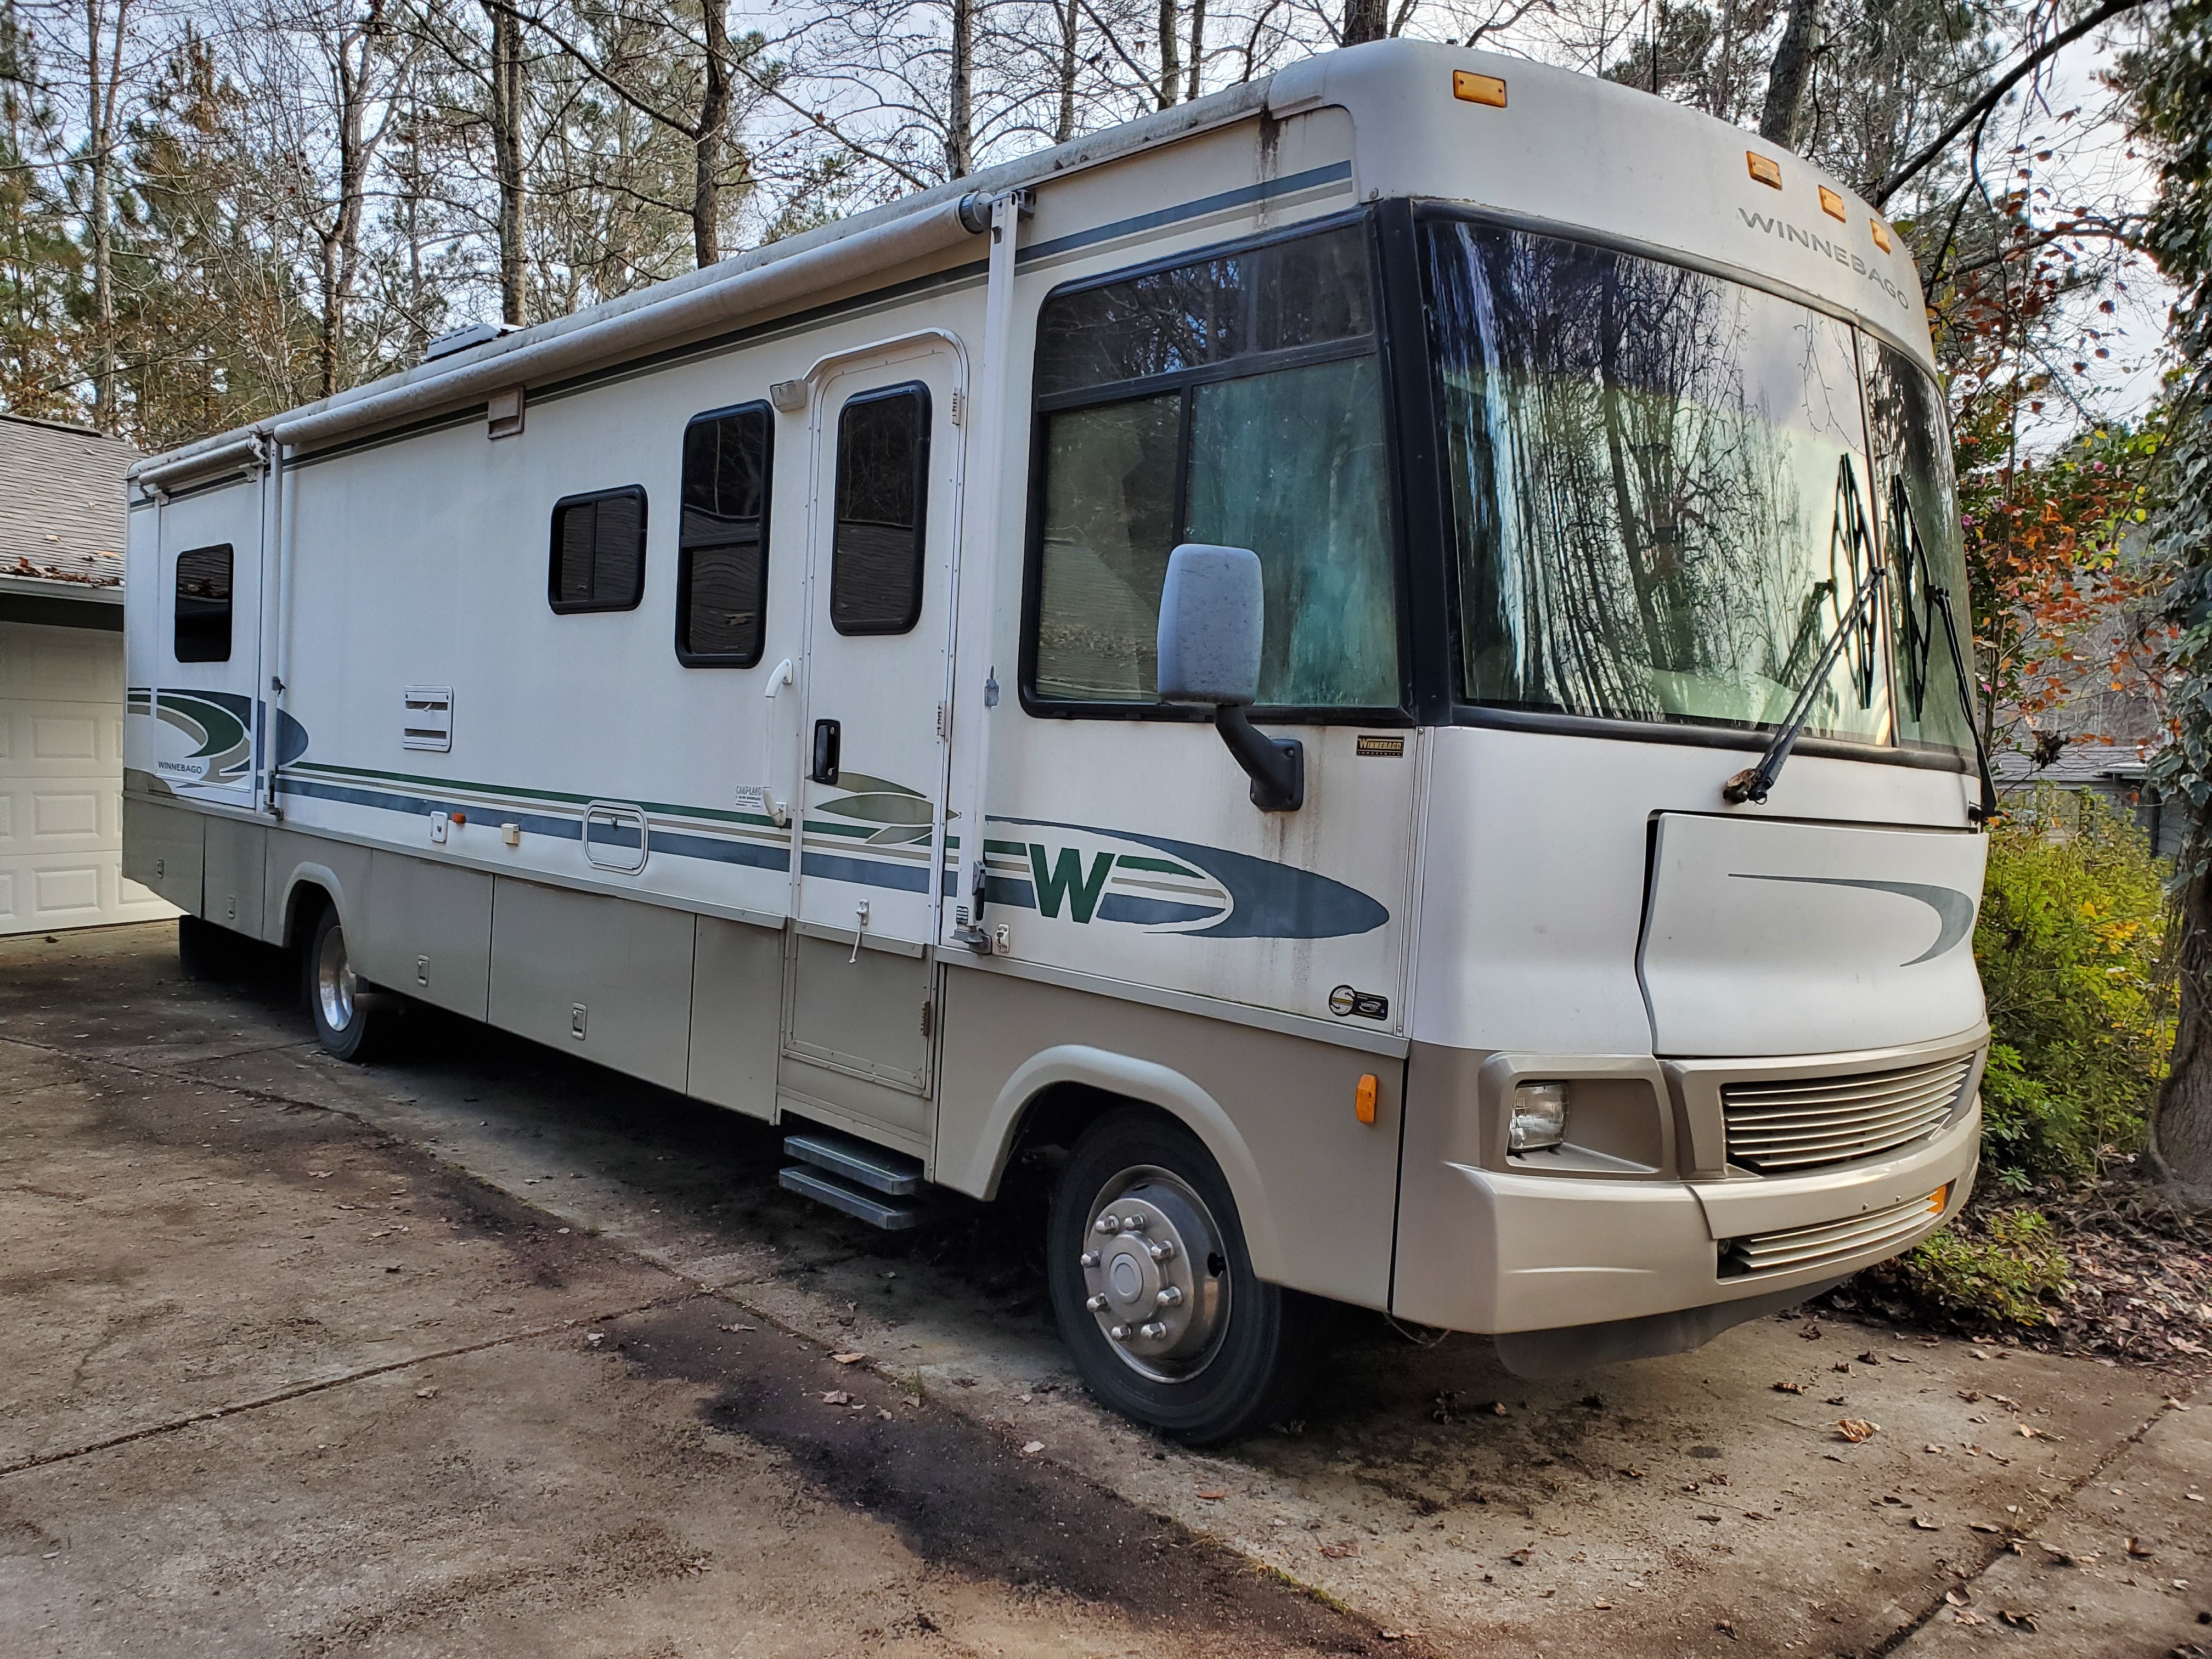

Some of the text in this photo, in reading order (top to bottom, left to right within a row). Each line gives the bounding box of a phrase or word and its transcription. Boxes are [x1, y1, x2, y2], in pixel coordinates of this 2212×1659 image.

[1738, 207, 1909, 309] WINNEBAGO
[158, 761, 202, 774] WINNEBAGO
[1359, 738, 1402, 750] WINNEBAGO
[1029, 843, 1116, 924] W
